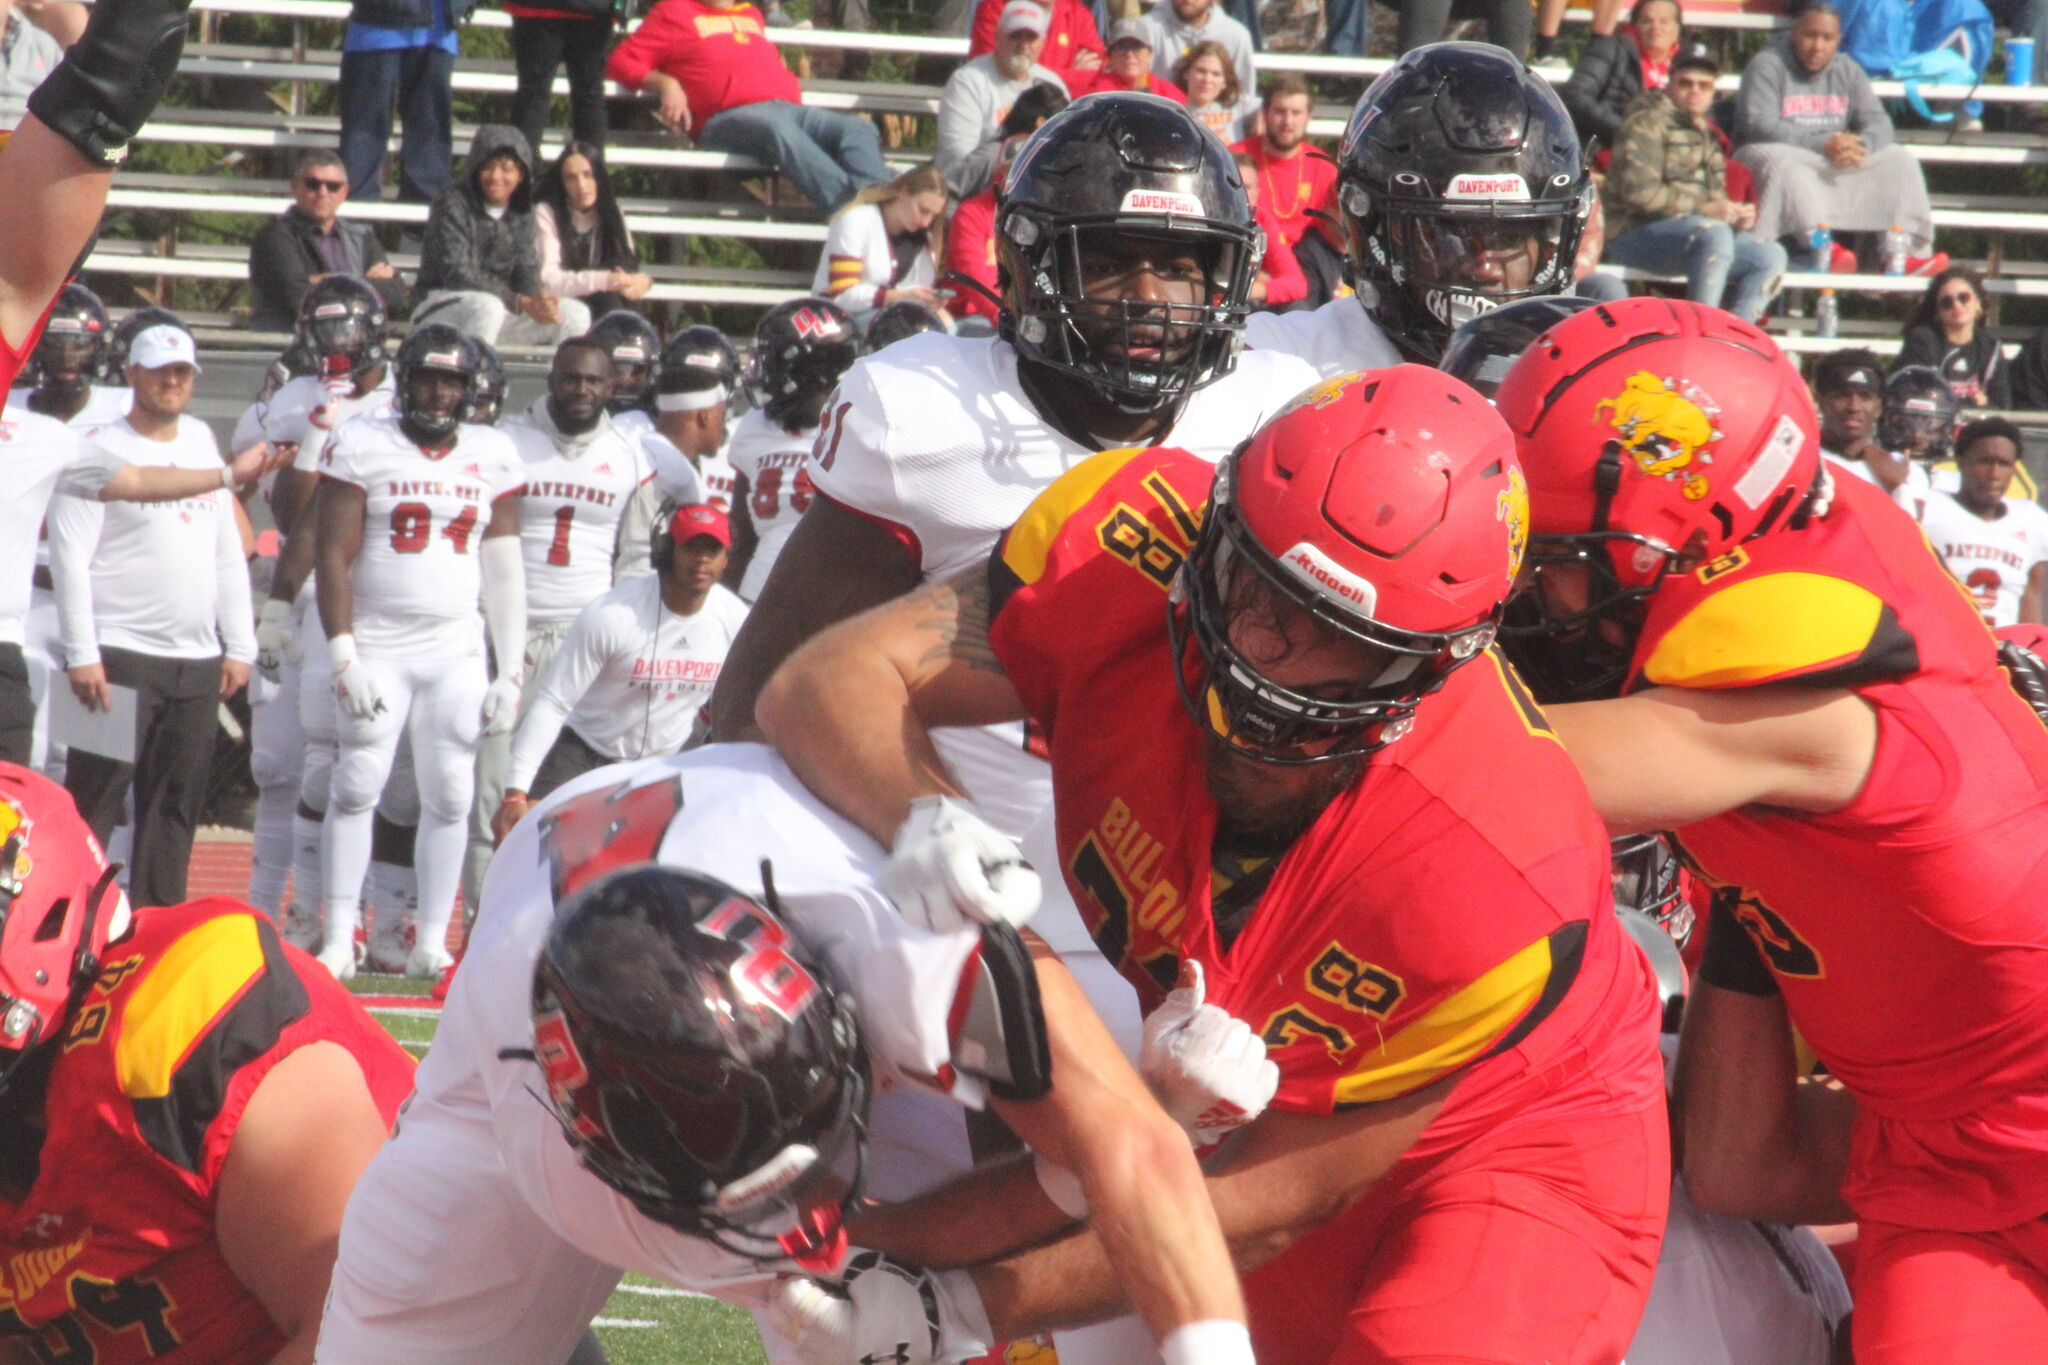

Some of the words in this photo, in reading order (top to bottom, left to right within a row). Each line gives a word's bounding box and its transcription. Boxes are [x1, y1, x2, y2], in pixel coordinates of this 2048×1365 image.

[1457, 179, 1521, 193] DAVENPORT
[1131, 194, 1195, 213] DAVENPORT
[791, 307, 841, 338] DU
[389, 481, 481, 501] DAVENORT
[520, 481, 616, 507] DAVENPORT
[389, 501, 479, 554] 94
[546, 505, 576, 567] 1
[1288, 552, 1365, 604] Riddell
[1258, 940, 1408, 1055] 78
